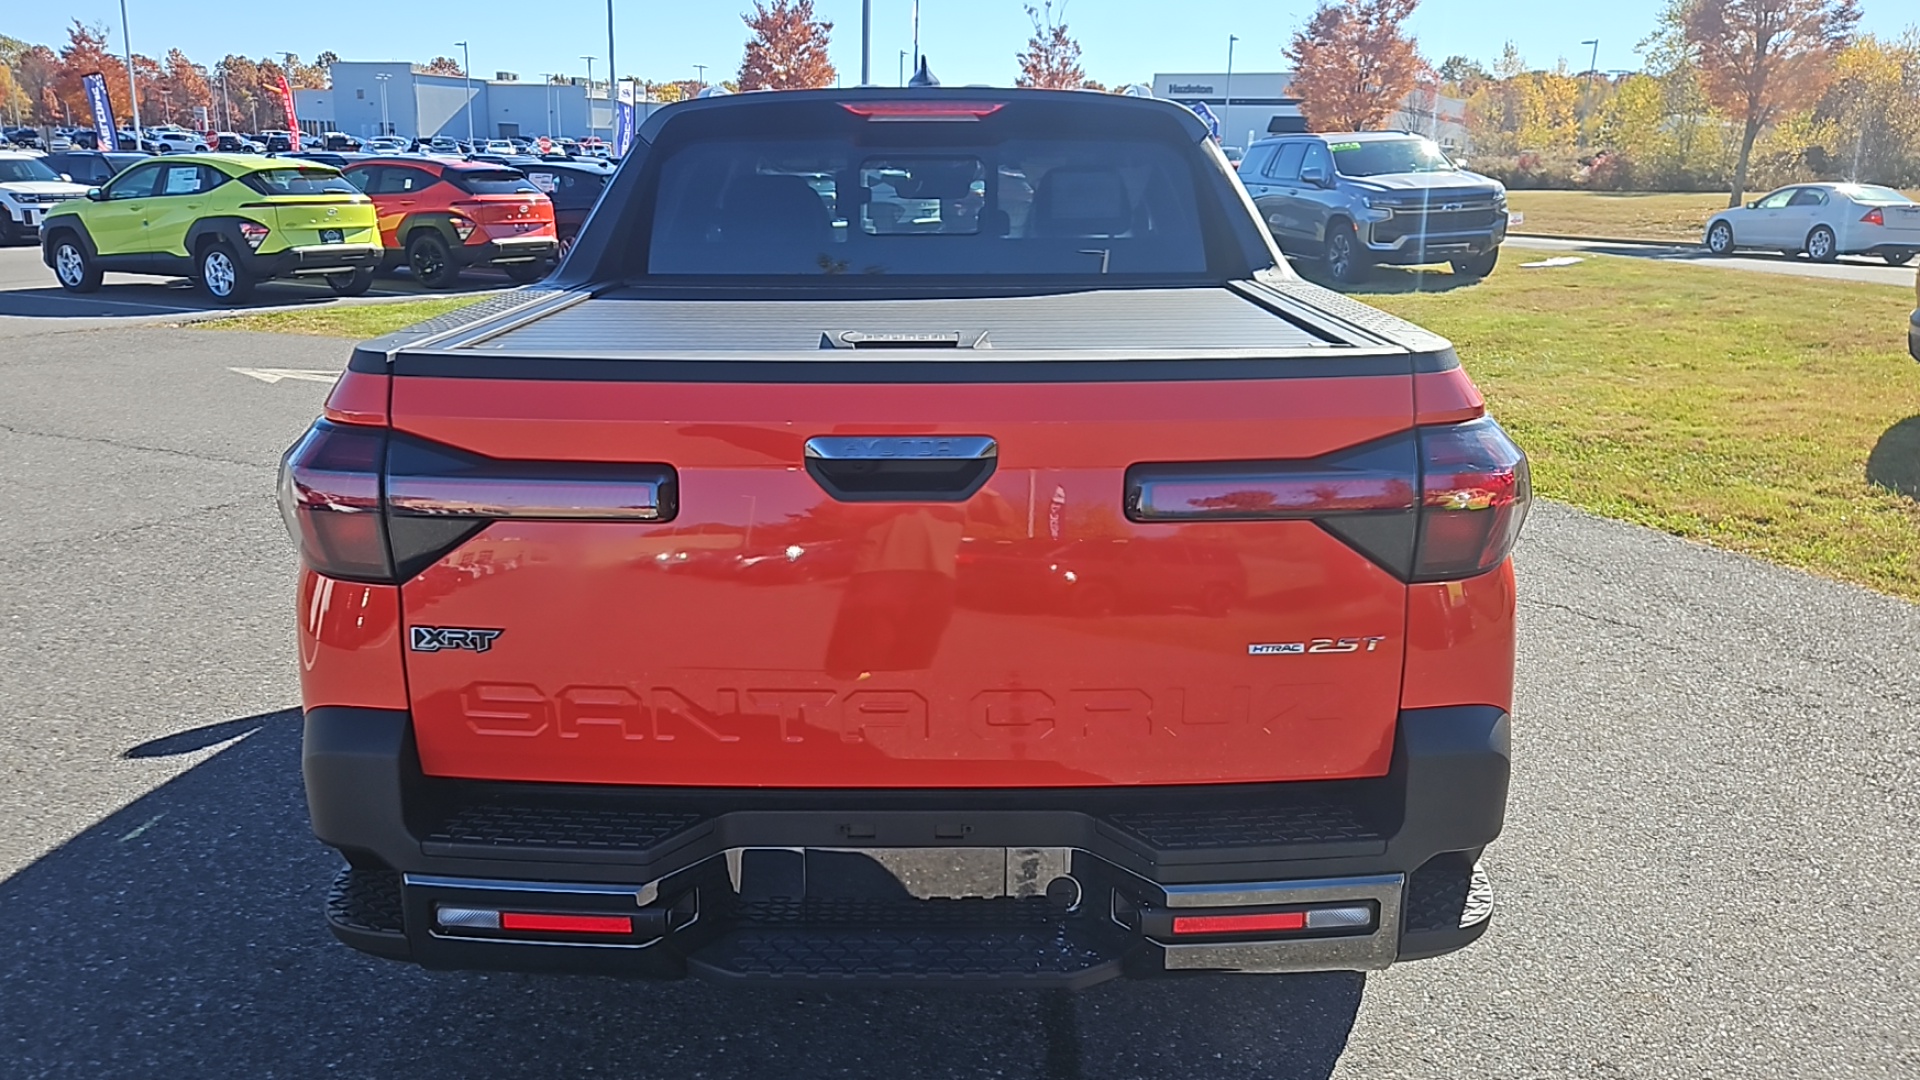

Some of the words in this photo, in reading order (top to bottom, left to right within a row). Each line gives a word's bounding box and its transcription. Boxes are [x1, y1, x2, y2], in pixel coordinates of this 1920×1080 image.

[1168, 83, 1214, 95] Hazleton
[91, 86, 113, 150] WELCOME
[418, 627, 504, 652] XRT
[1250, 643, 1303, 654] HTRAC
[460, 680, 931, 743] SANTA
[969, 680, 1344, 741] CRUZ
